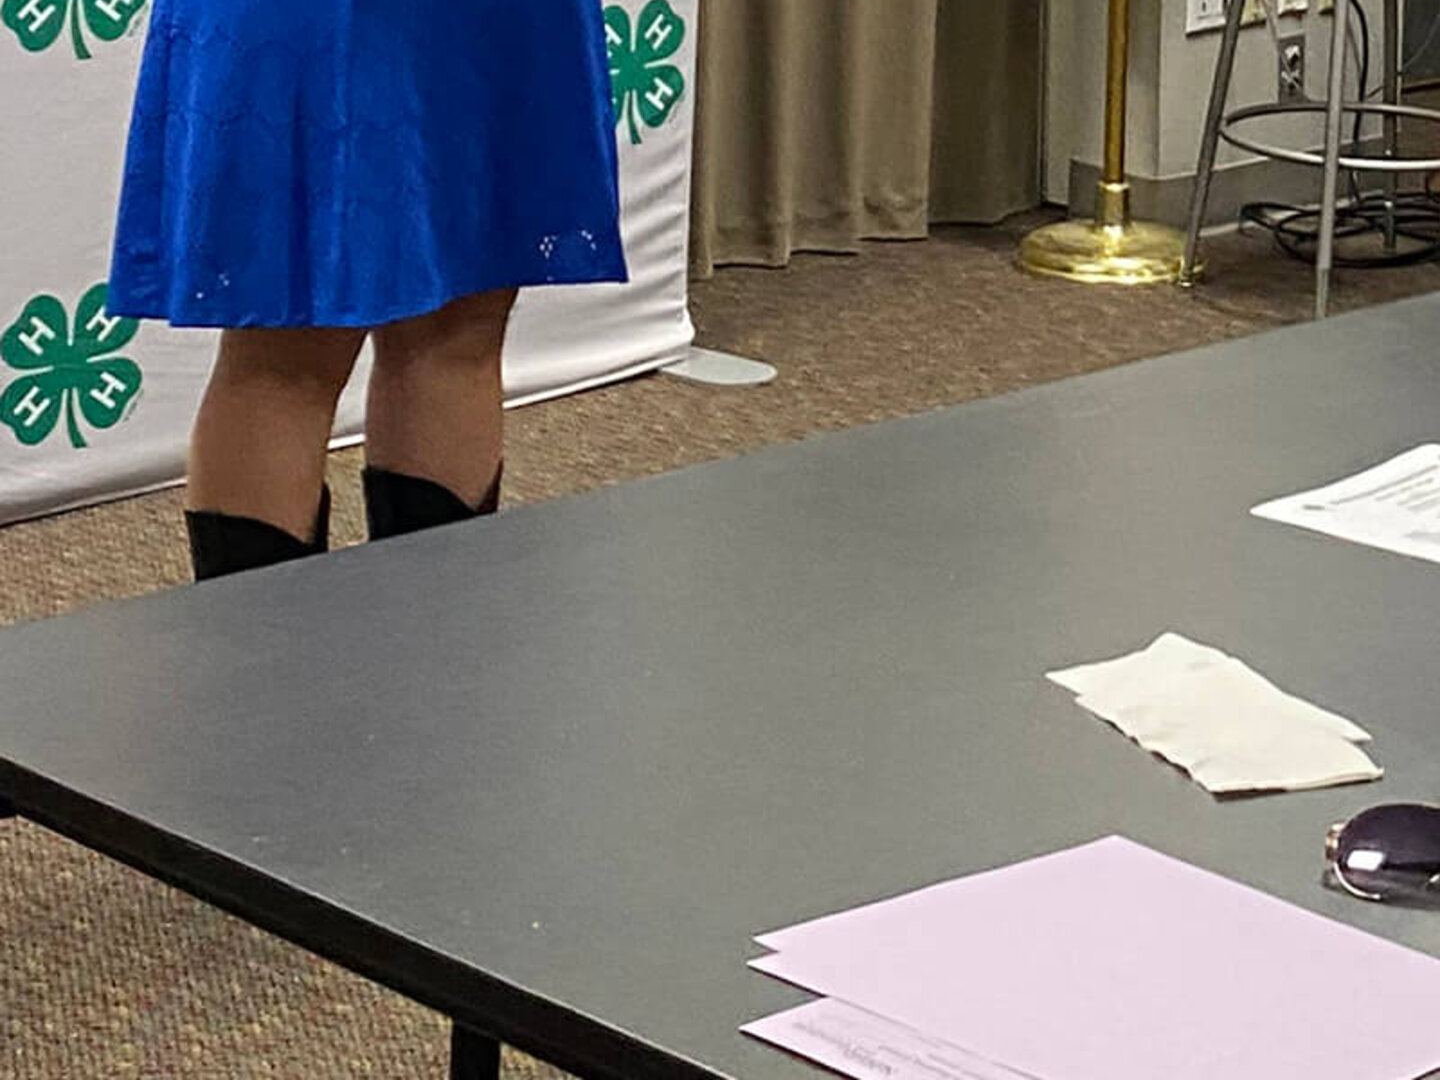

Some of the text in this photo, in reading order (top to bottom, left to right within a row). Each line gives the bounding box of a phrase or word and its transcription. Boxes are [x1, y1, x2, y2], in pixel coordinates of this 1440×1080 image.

[644, 14, 673, 50] H
[645, 77, 674, 111] H
[18, 316, 56, 355] H
[13, 386, 50, 427] H
[90, 371, 127, 409] H
